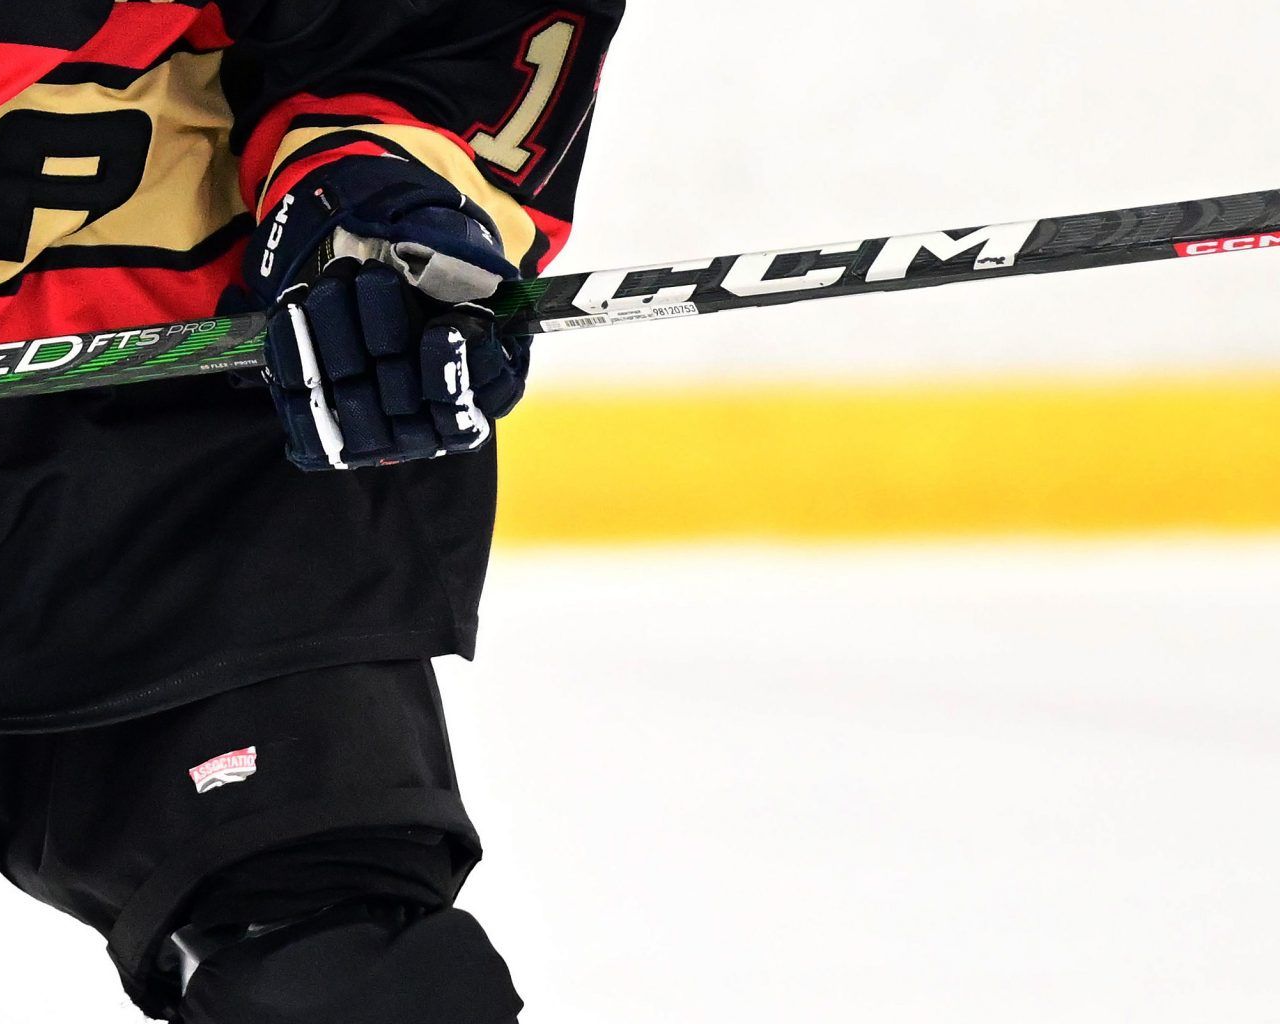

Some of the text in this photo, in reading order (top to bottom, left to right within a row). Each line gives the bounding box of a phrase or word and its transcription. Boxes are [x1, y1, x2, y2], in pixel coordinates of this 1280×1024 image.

[260, 193, 295, 278] CCM
[572, 219, 1040, 314] CCM
[87, 327, 165, 353] FT5
[166, 320, 217, 337] PRO
[652, 305, 697, 317] 98120753
